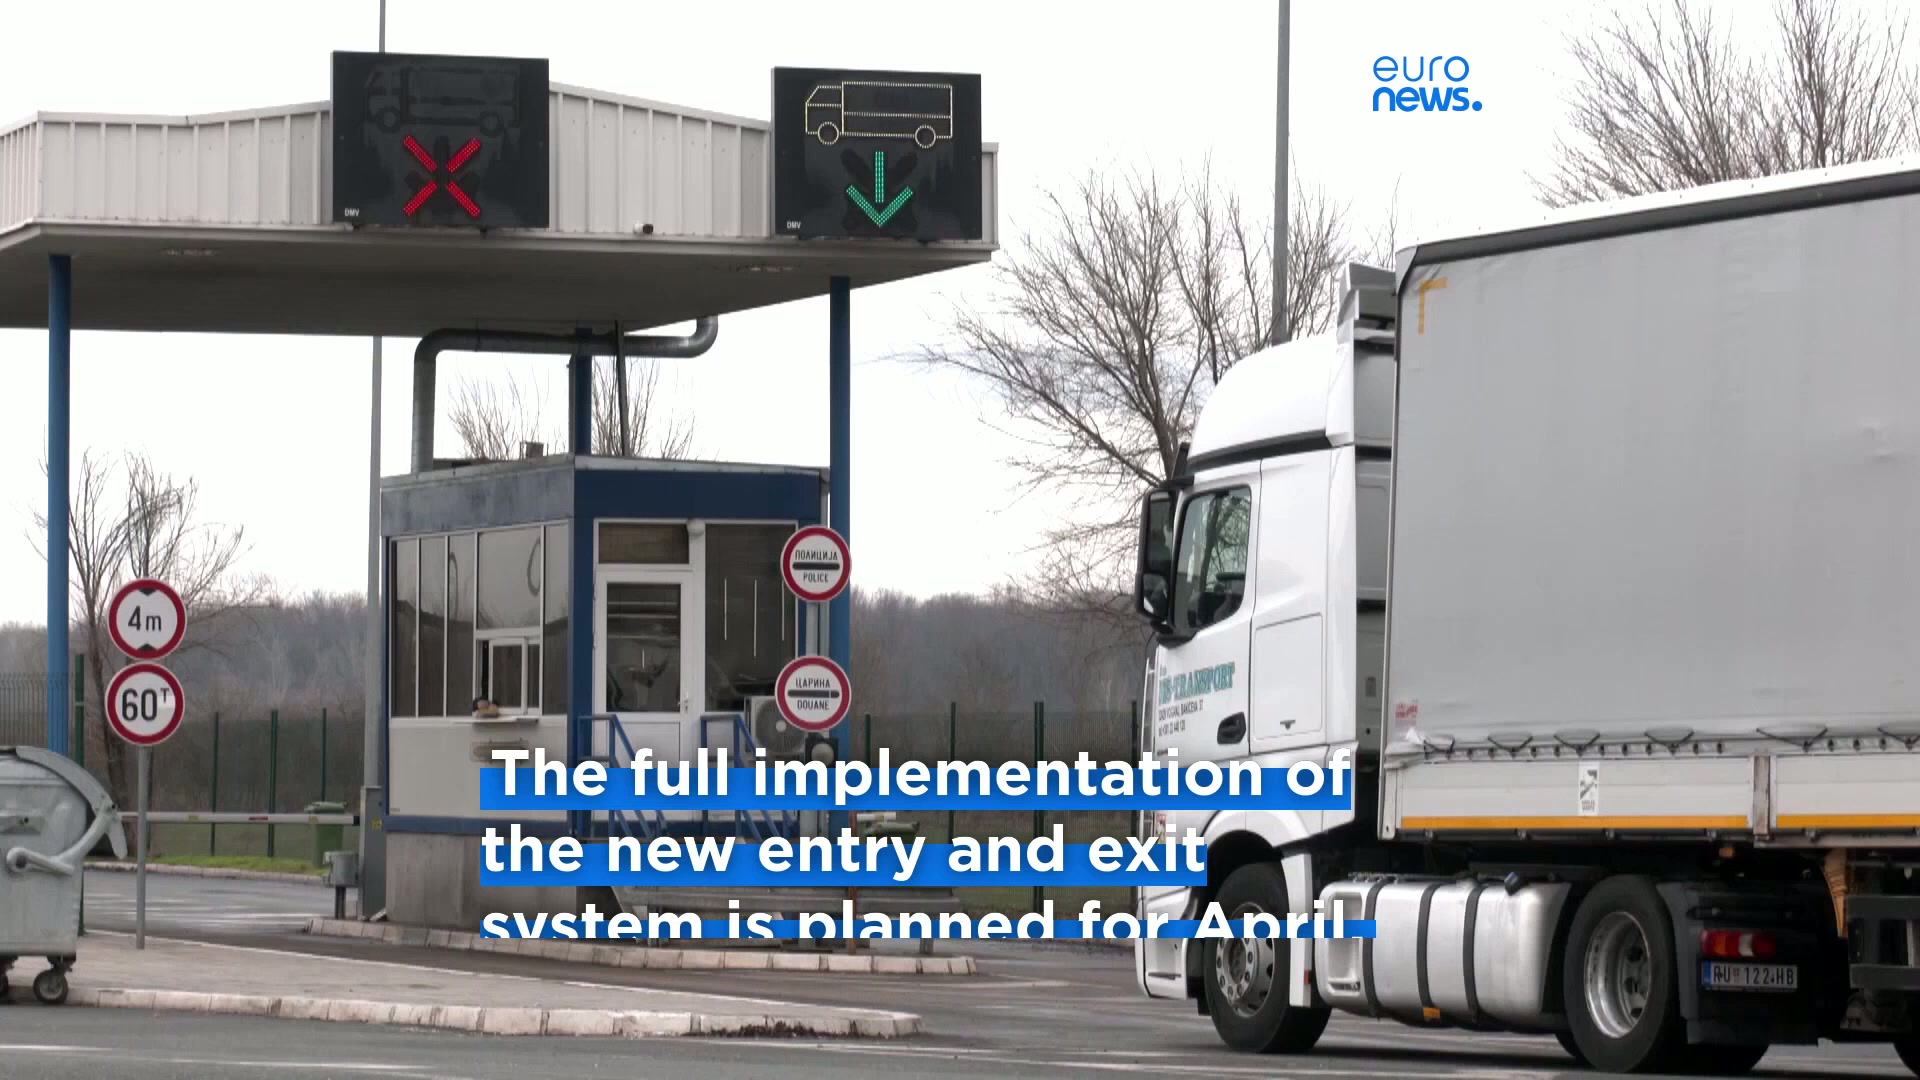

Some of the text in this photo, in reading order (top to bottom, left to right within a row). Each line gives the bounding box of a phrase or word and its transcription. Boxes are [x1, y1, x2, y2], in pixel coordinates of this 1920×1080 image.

[803, 572, 829, 583] POLICE
[795, 678, 831, 689] ЦАРИНА
[797, 700, 829, 711] DOUANE
